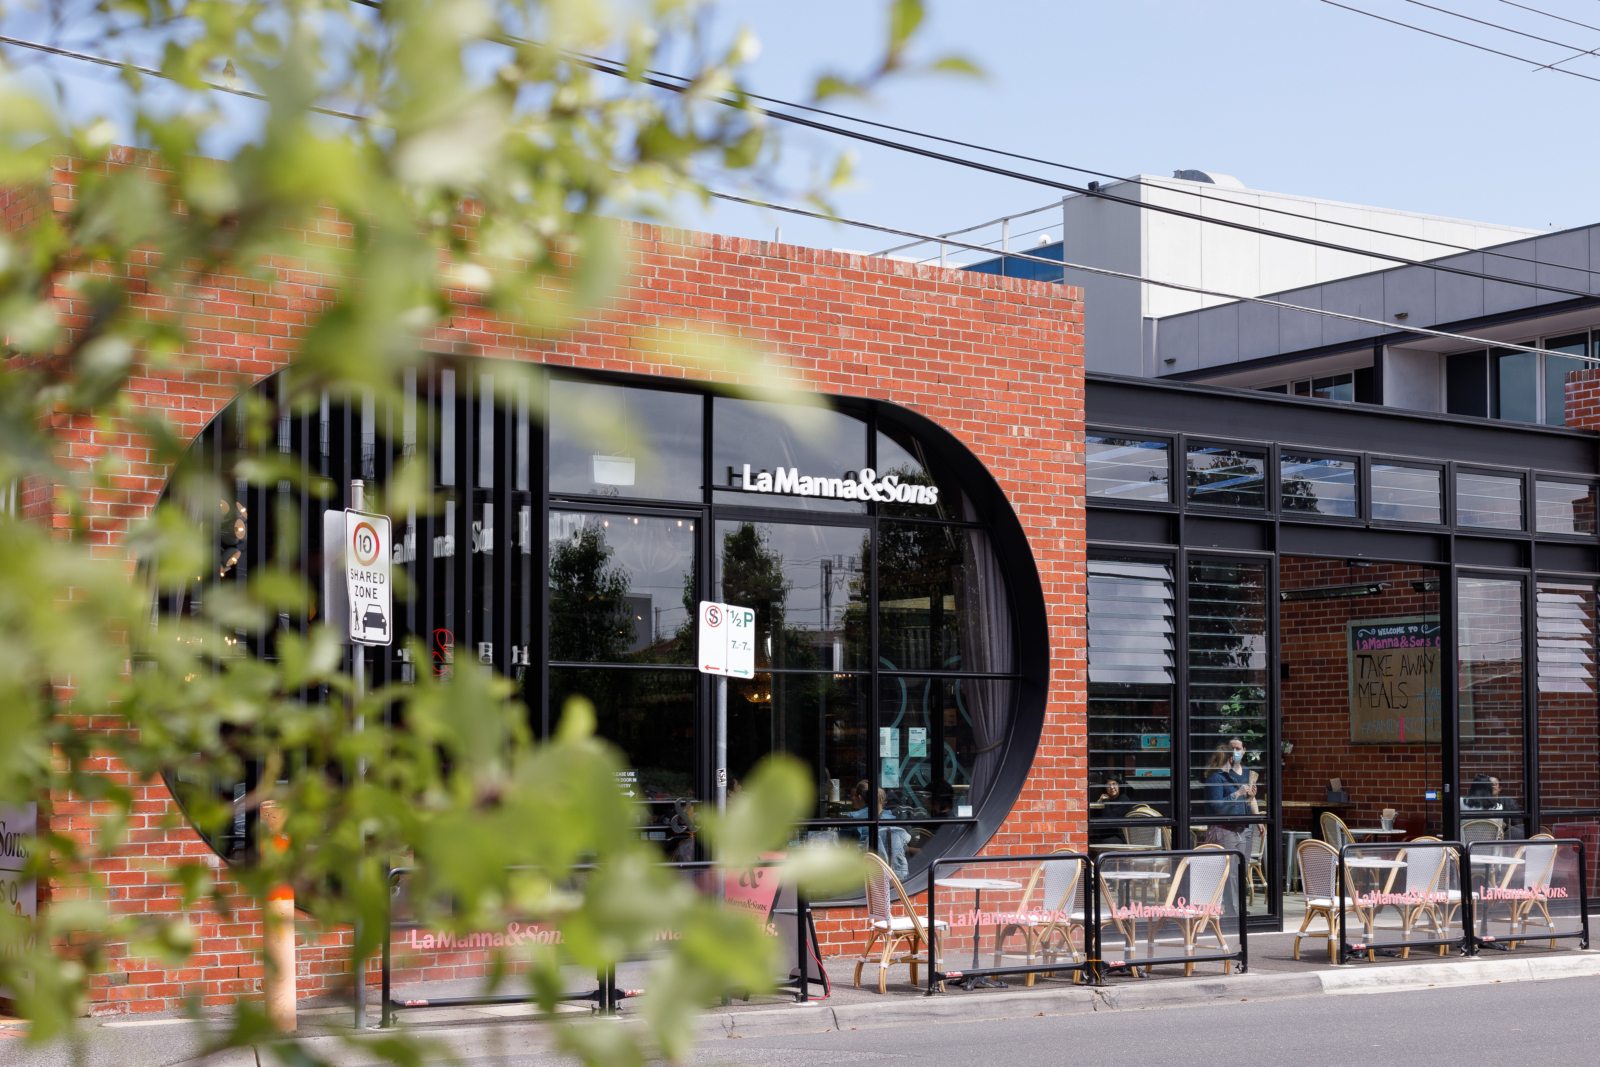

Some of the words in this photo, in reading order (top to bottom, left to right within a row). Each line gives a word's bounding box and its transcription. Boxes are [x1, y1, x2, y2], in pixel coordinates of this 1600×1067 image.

[358, 534, 372, 554] 10
[350, 568, 385, 585] SHARED
[354, 585, 378, 600] ZONE
[1378, 626, 1405, 637] WELCOME
[1408, 626, 1418, 634] TO
[1356, 654, 1393, 679] TAKE
[1400, 653, 1435, 677] AWAY
[1358, 681, 1409, 709] MEALS
